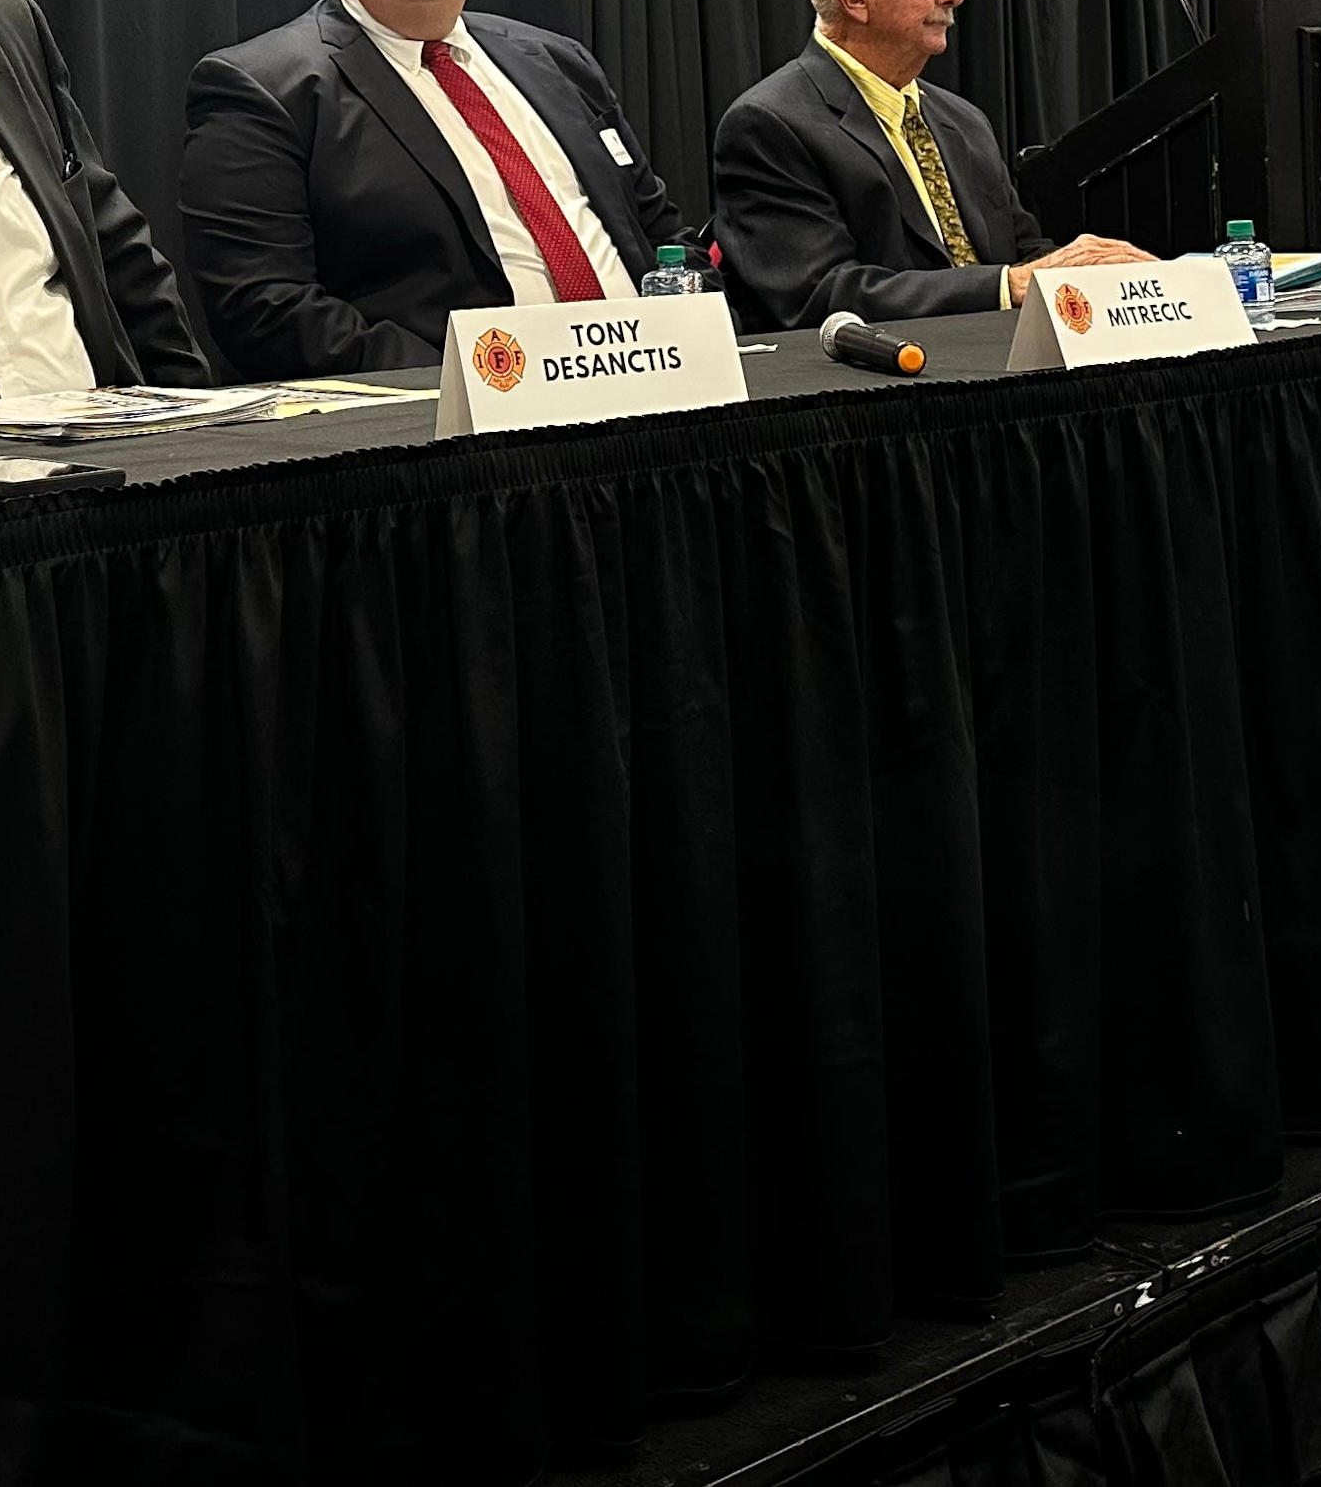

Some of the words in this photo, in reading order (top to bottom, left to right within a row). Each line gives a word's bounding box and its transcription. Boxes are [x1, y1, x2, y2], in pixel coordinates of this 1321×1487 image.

[1120, 279, 1164, 301] JAKE
[1107, 301, 1193, 327] MITRECIC
[491, 330, 501, 341] A
[571, 319, 640, 348] TONY
[543, 346, 682, 382] DESANCTIS
